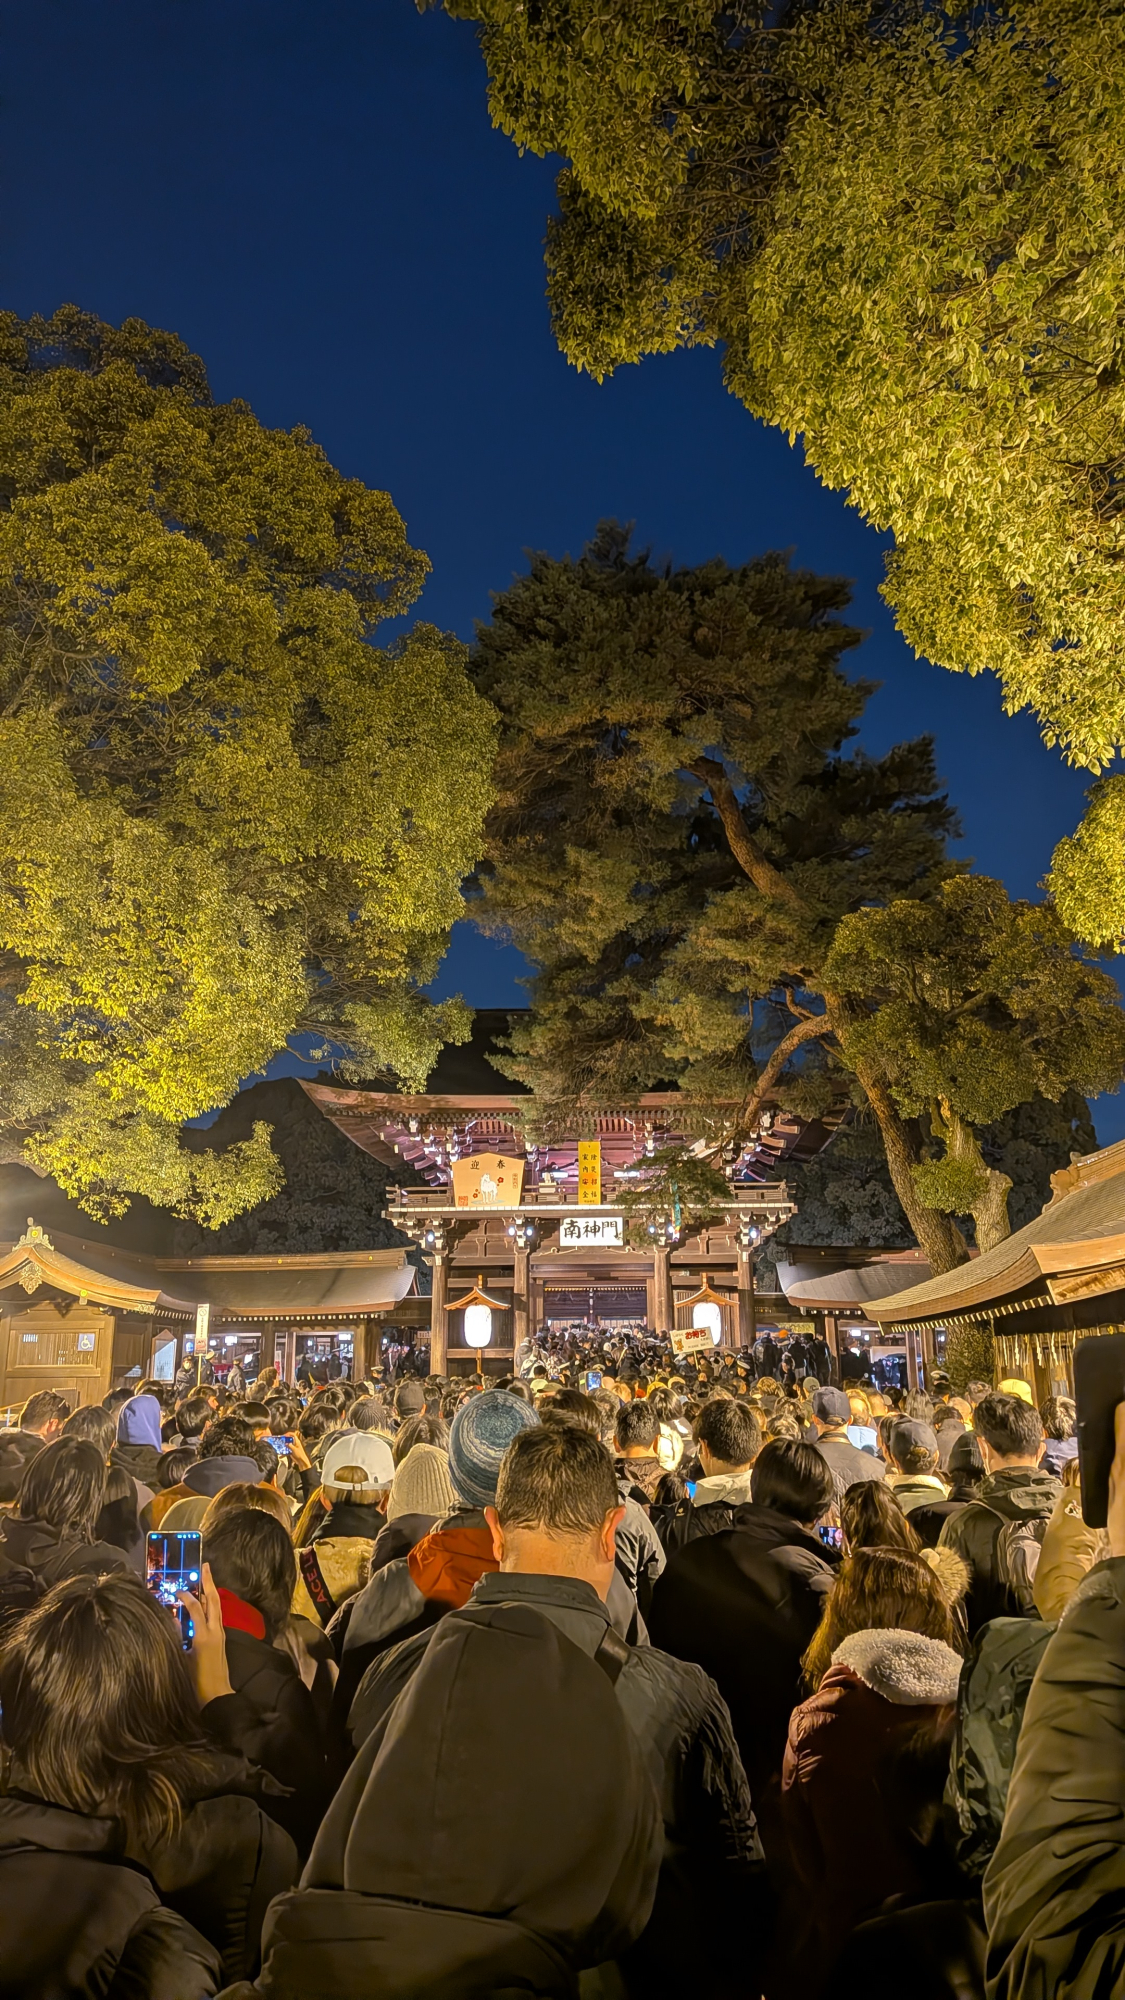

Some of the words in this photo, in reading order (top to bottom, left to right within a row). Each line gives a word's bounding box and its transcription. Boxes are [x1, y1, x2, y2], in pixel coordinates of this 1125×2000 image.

[470, 1159, 506, 1170] 迎春
[564, 1219, 619, 1239] 南神門
[307, 1568, 331, 1608] ACE
